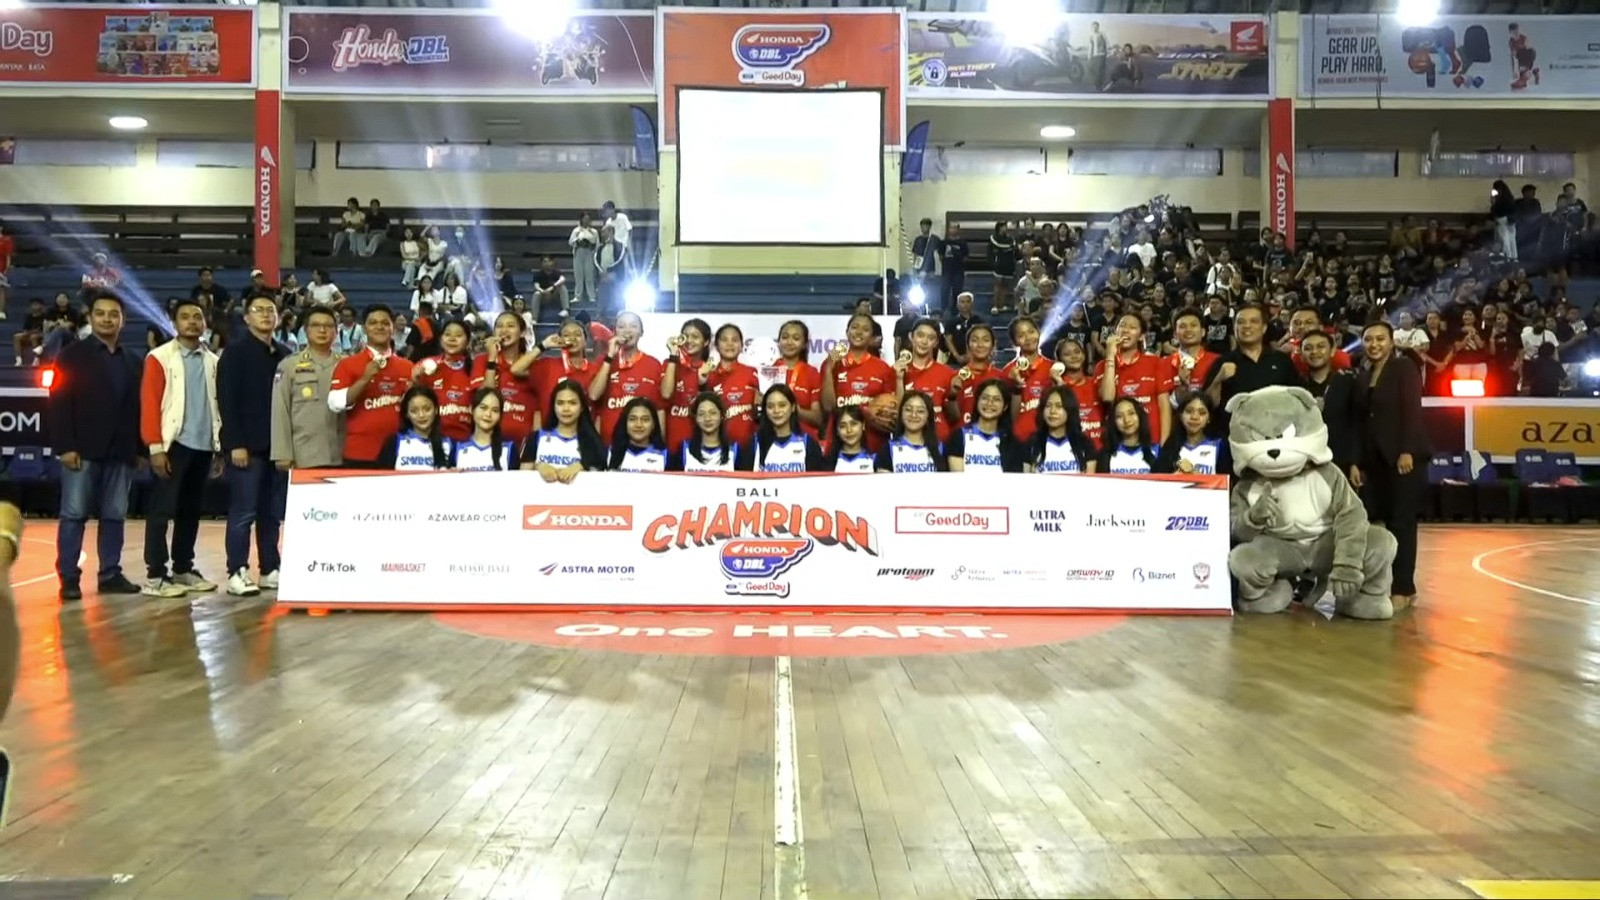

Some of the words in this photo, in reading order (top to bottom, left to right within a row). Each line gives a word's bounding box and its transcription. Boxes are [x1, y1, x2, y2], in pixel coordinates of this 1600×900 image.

[2, 22, 52, 56] Day
[333, 25, 402, 71] Honda
[1328, 37, 1358, 54] GEAR
[759, 49, 782, 59] DBL
[1321, 56, 1348, 74] PLAY
[762, 71, 784, 80] Good
[784, 71, 802, 82] Day
[261, 167, 271, 237] HONDA
[736, 488, 779, 497] BALI
[551, 514, 628, 526] HONDA
[925, 512, 960, 526] Good
[962, 512, 990, 530] Day
[1029, 510, 1066, 521] ULTRA
[1086, 514, 1146, 527] Jackson
[1033, 522, 1062, 532] MILK
[1186, 516, 1209, 527] DBL
[641, 501, 879, 557] CHAMPION
[744, 547, 789, 555] HONDA
[320, 562, 356, 572] TikTok
[381, 563, 426, 573] MAINBASKET
[561, 566, 594, 574] ASTRA
[597, 566, 635, 574] MOTOR
[742, 559, 766, 570] DBL
[1148, 572, 1176, 580] Biznet
[746, 581, 768, 590] Good
[769, 581, 786, 593] Day
[554, 623, 714, 637] One
[732, 624, 1009, 639] HEART.
